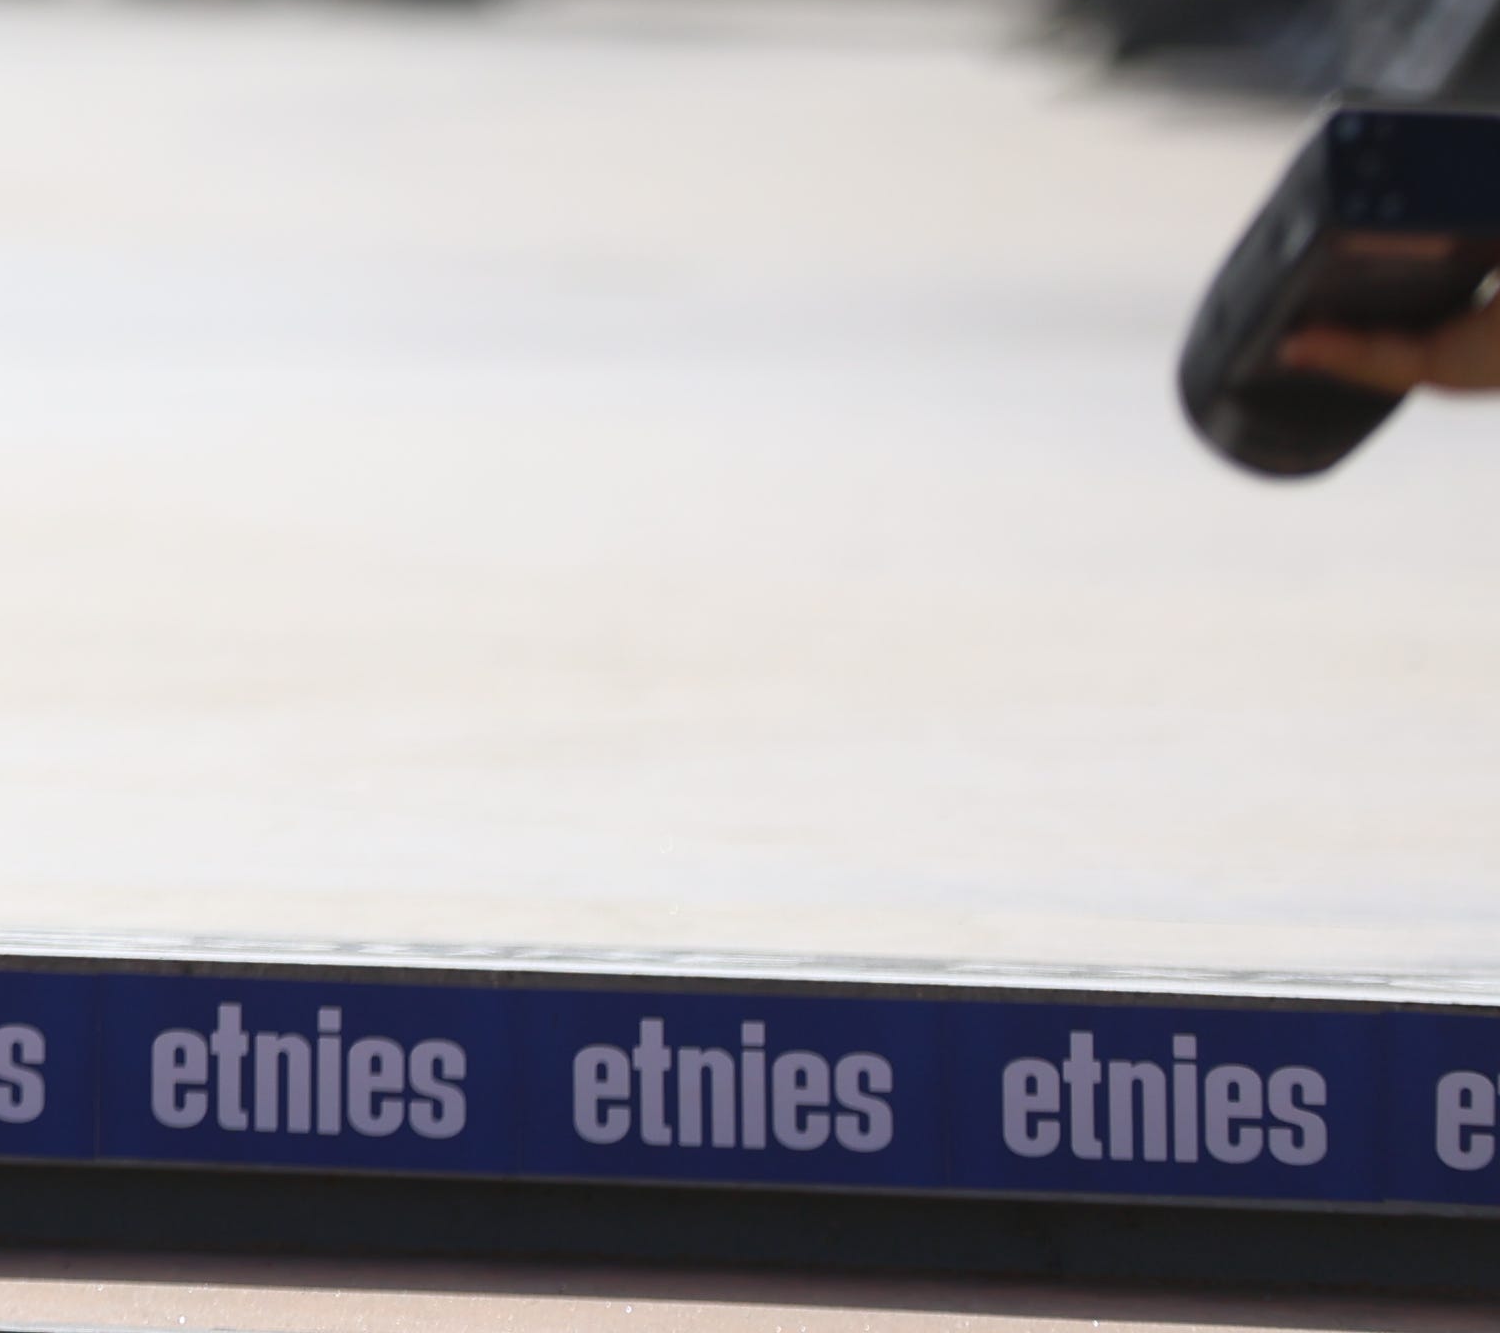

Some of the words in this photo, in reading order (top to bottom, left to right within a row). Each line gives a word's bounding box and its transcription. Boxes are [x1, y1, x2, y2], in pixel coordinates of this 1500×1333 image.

[151, 1002, 467, 1139] etnies
[572, 1017, 894, 1153] etnies
[1001, 1030, 1328, 1166] etnies
